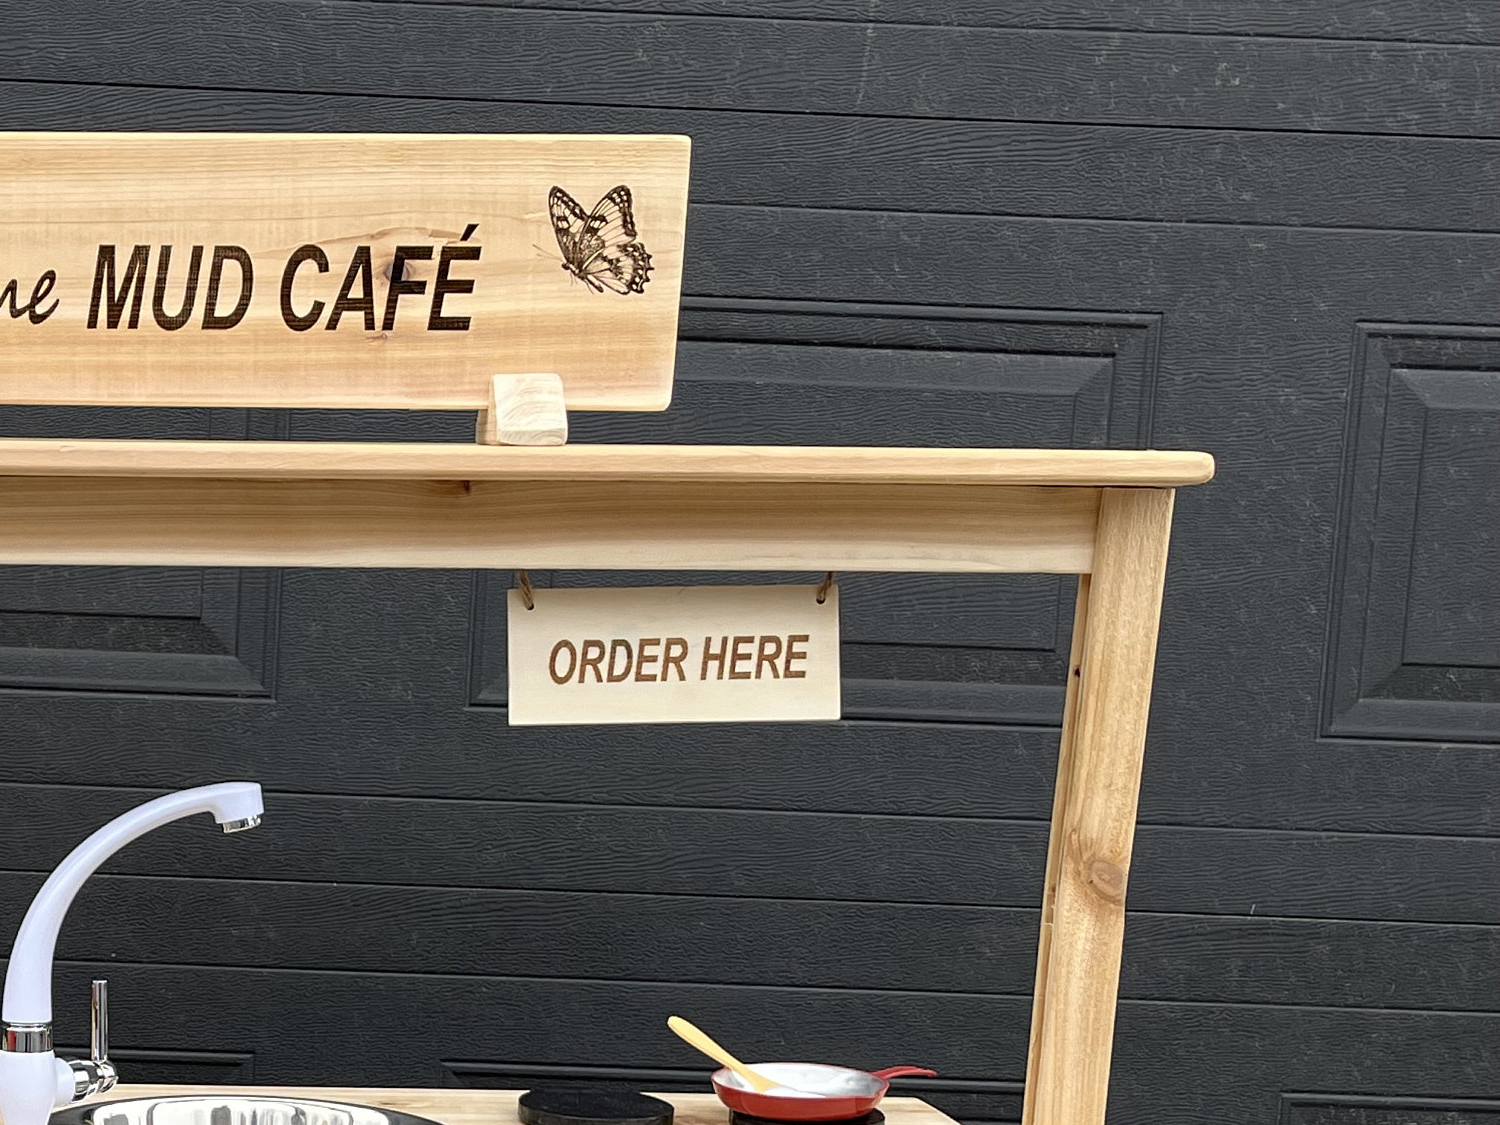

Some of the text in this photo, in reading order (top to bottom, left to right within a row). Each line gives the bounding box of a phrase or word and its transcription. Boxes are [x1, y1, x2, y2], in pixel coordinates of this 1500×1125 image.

[86, 244, 254, 331] MUD
[280, 223, 482, 332] CAFÉ
[548, 634, 810, 685] ORDER HERE
